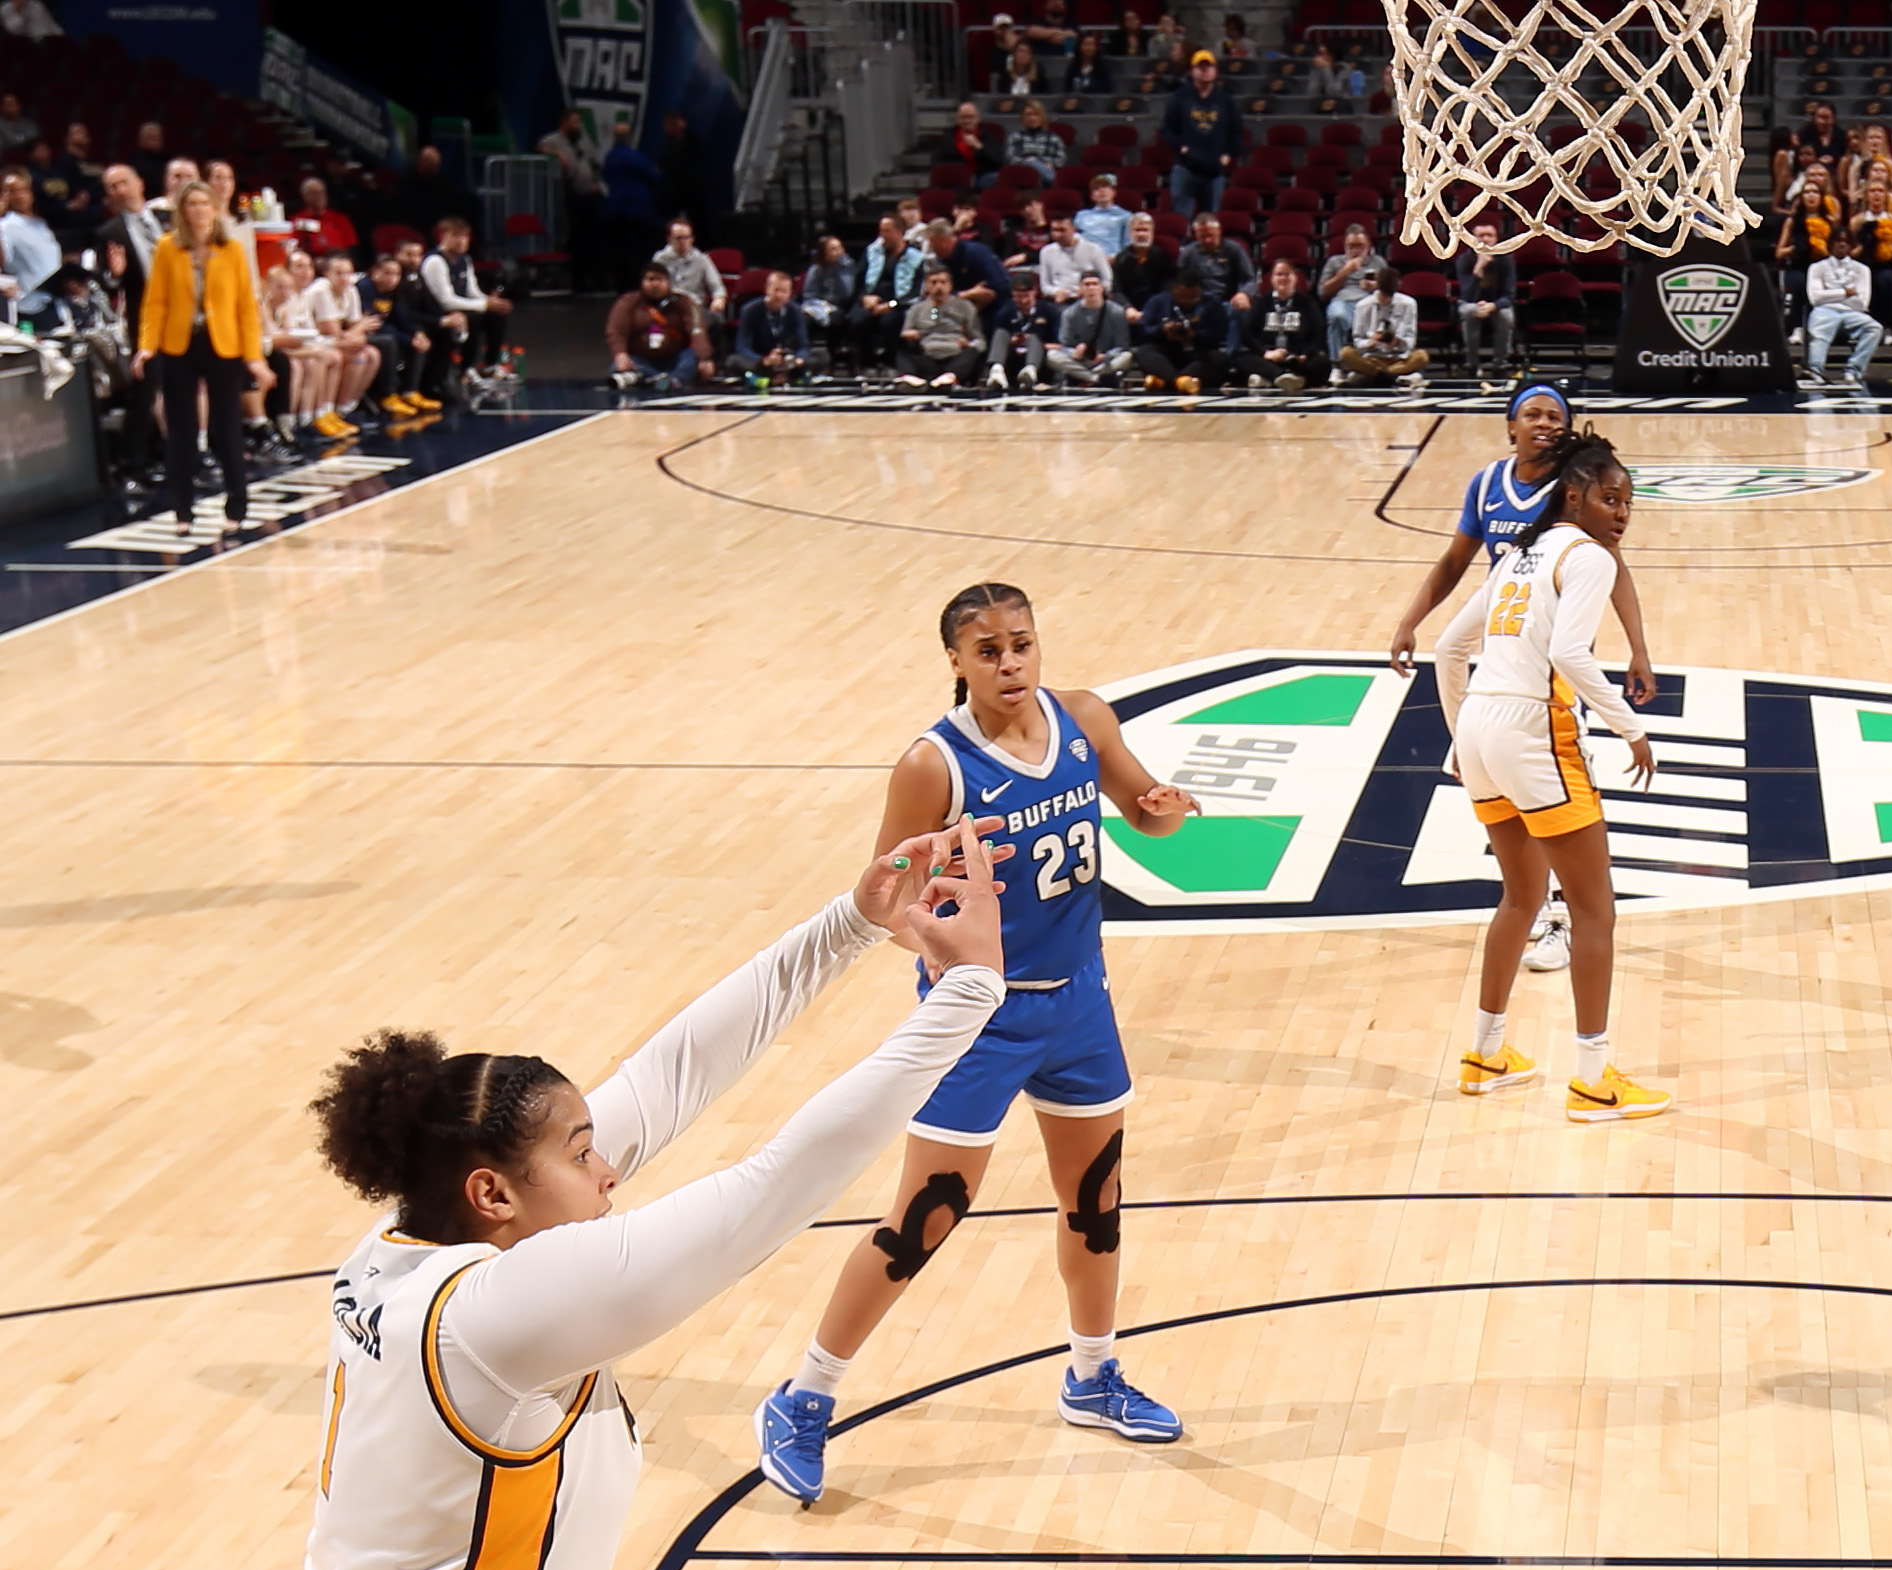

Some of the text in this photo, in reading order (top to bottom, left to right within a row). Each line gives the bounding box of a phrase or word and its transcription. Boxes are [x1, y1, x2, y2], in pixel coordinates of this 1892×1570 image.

[1668, 293, 1738, 312] MAC
[1637, 350, 1698, 367] Credit
[1488, 519, 1533, 535] BUFF
[1488, 581, 1532, 636] 22
[1006, 780, 1097, 835] BUFFALO
[1031, 820, 1098, 901] 23
